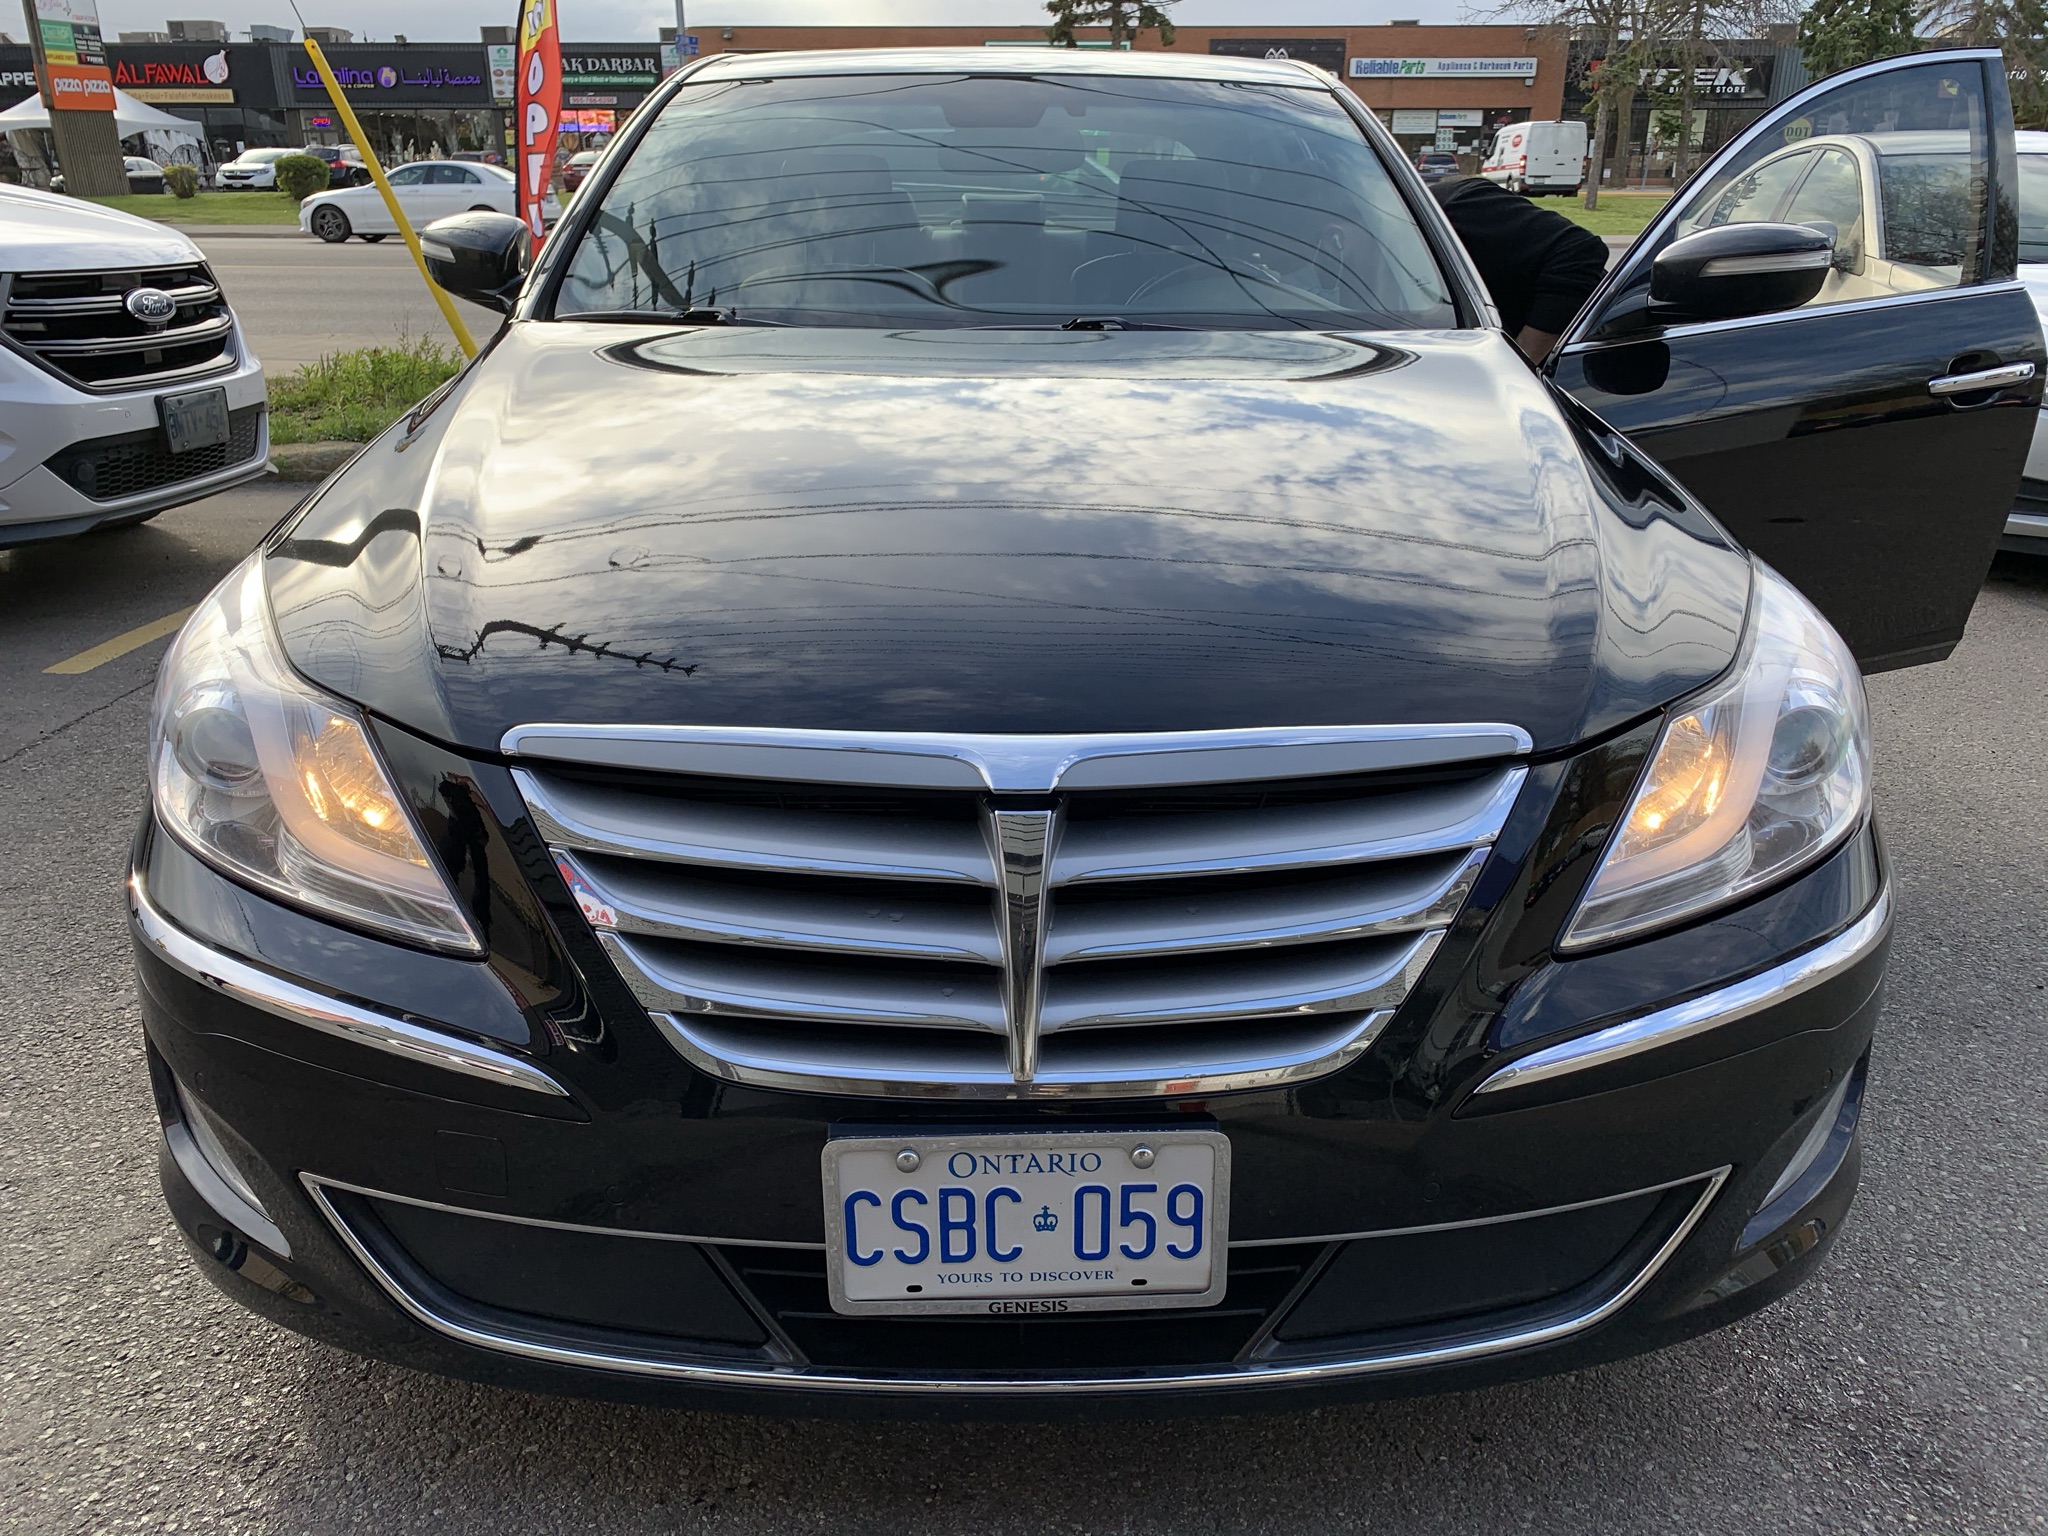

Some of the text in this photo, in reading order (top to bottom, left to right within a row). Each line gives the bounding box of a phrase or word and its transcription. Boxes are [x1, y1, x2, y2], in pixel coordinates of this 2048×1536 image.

[86, 55, 104, 64] TREK
[586, 57, 659, 74] DARBAR
[1437, 61, 1472, 71] Appliance
[1513, 61, 1534, 70] Parts
[116, 59, 209, 84] ALFAWAL
[54, 78, 111, 97] pizza pizza
[142, 295, 169, 314] Ford
[844, 1183, 1205, 1267] CSBC 059
[937, 1269, 1115, 1285] YOURS TO DISCOVER
[988, 1299, 1069, 1314] GENESIS
